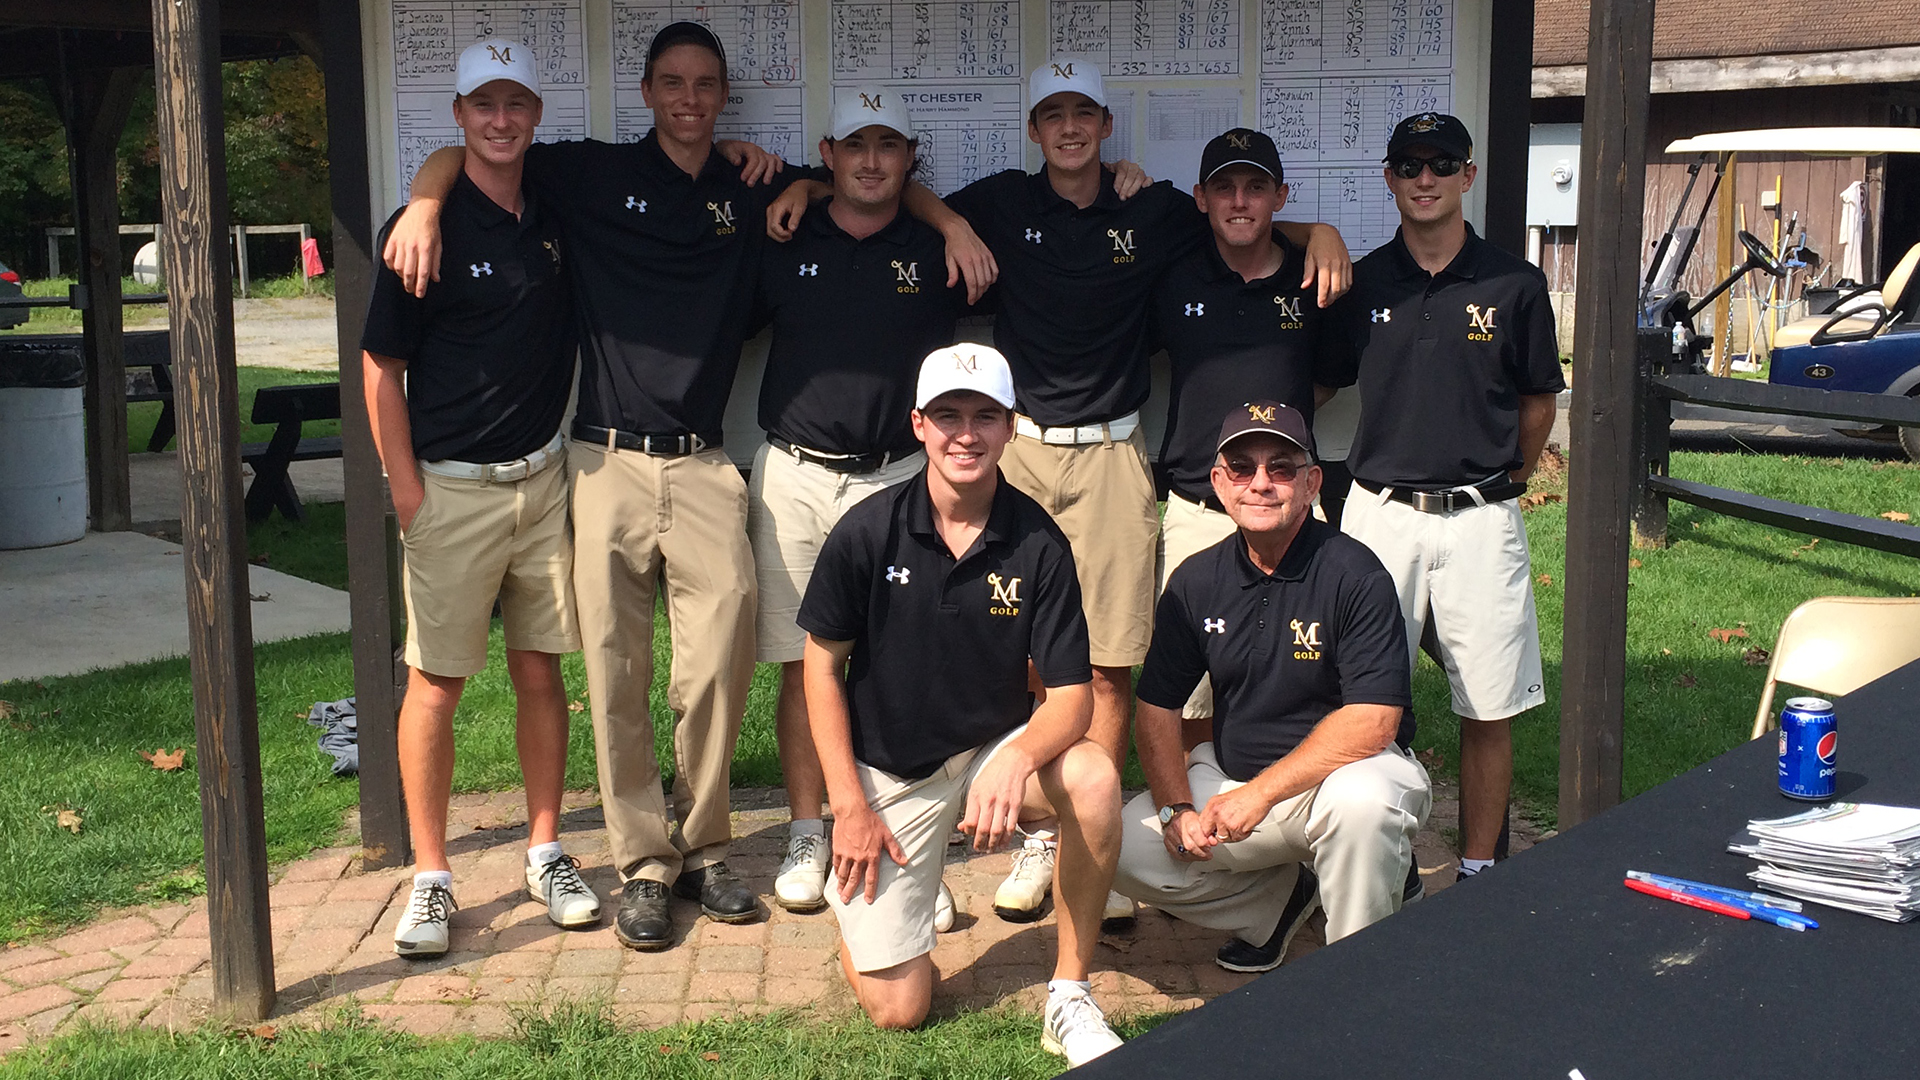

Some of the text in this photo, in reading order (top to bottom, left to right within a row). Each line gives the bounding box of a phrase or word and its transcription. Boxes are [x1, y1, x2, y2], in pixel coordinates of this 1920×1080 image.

[959, 3, 975, 15] 83
[1135, 0, 1147, 13] 81
[1180, 0, 1194, 10] 74
[1419, 5, 1443, 17] 160
[740, 6, 756, 17] 74
[767, 6, 788, 18] 145
[1178, 12, 1194, 23] 85
[1206, 11, 1228, 23] 167
[1279, 9, 1311, 23] Smith
[1346, 7, 1364, 20] 85
[1392, 7, 1408, 17] 75
[986, 15, 1009, 27] 158
[1133, 12, 1149, 25] 82
[1419, 18, 1444, 30] 145
[475, 21, 494, 35] 76
[520, 20, 537, 34] 74
[546, 21, 565, 34] 150
[765, 19, 790, 31] 154
[1133, 24, 1151, 38] 82
[1178, 24, 1194, 36] 83
[1205, 23, 1226, 35] 165
[1346, 20, 1364, 33] 73
[1391, 20, 1407, 31] 72
[740, 32, 756, 43] 75
[765, 32, 786, 43] 149
[914, 28, 931, 42] 80
[960, 29, 973, 40] 81
[986, 28, 1004, 40] 161
[1346, 32, 1363, 46] 85
[1417, 31, 1441, 43] 173
[521, 35, 537, 46] 83
[546, 35, 565, 46] 159
[960, 41, 976, 52] 76
[985, 41, 1008, 52] 153
[1133, 39, 1151, 51] 87
[1178, 37, 1191, 49] 81
[1204, 36, 1227, 48] 168
[545, 46, 568, 59] 152
[765, 44, 788, 56] 154
[1344, 45, 1361, 58] 93
[1389, 45, 1404, 56] 81
[1416, 44, 1442, 55] 174
[740, 56, 757, 67] 76
[767, 55, 788, 67] 154
[958, 52, 978, 65] 92
[986, 53, 1004, 64] 181
[545, 60, 562, 70] 161
[987, 66, 1014, 76] 640
[1121, 62, 1147, 75] 332
[1165, 62, 1191, 73] 323
[1204, 62, 1232, 73] 655
[551, 71, 579, 84] 609
[766, 67, 791, 80] 599
[902, 66, 921, 79] 321
[1344, 87, 1361, 98] 79
[1389, 86, 1404, 97] 72
[1414, 86, 1436, 97] 151
[901, 93, 983, 104] ST CHESTER
[1344, 98, 1361, 111] 84
[1388, 98, 1405, 110] 75
[1413, 98, 1438, 110] 159
[939, 105, 970, 113] HAMMOND
[1343, 111, 1361, 123] 73
[1387, 111, 1403, 123] 79
[960, 130, 976, 141] 76
[985, 130, 1006, 141] 151
[1342, 123, 1360, 136] 78
[770, 133, 791, 143] 154
[1342, 136, 1358, 149] 89
[961, 142, 978, 153] 74
[984, 142, 1007, 153] 153
[962, 155, 978, 165] 77
[985, 155, 1008, 165] 157
[962, 167, 978, 178] 77
[1343, 188, 1358, 202] 92
[716, 226, 736, 236] GOLF
[1112, 255, 1135, 264] GOLF
[896, 285, 920, 294] GOLF
[1280, 321, 1304, 330] GOLF
[1467, 332, 1493, 342] GOLF
[1812, 368, 1827, 377] 43
[989, 606, 1020, 616] GOLF
[1293, 651, 1321, 660] GOLF
